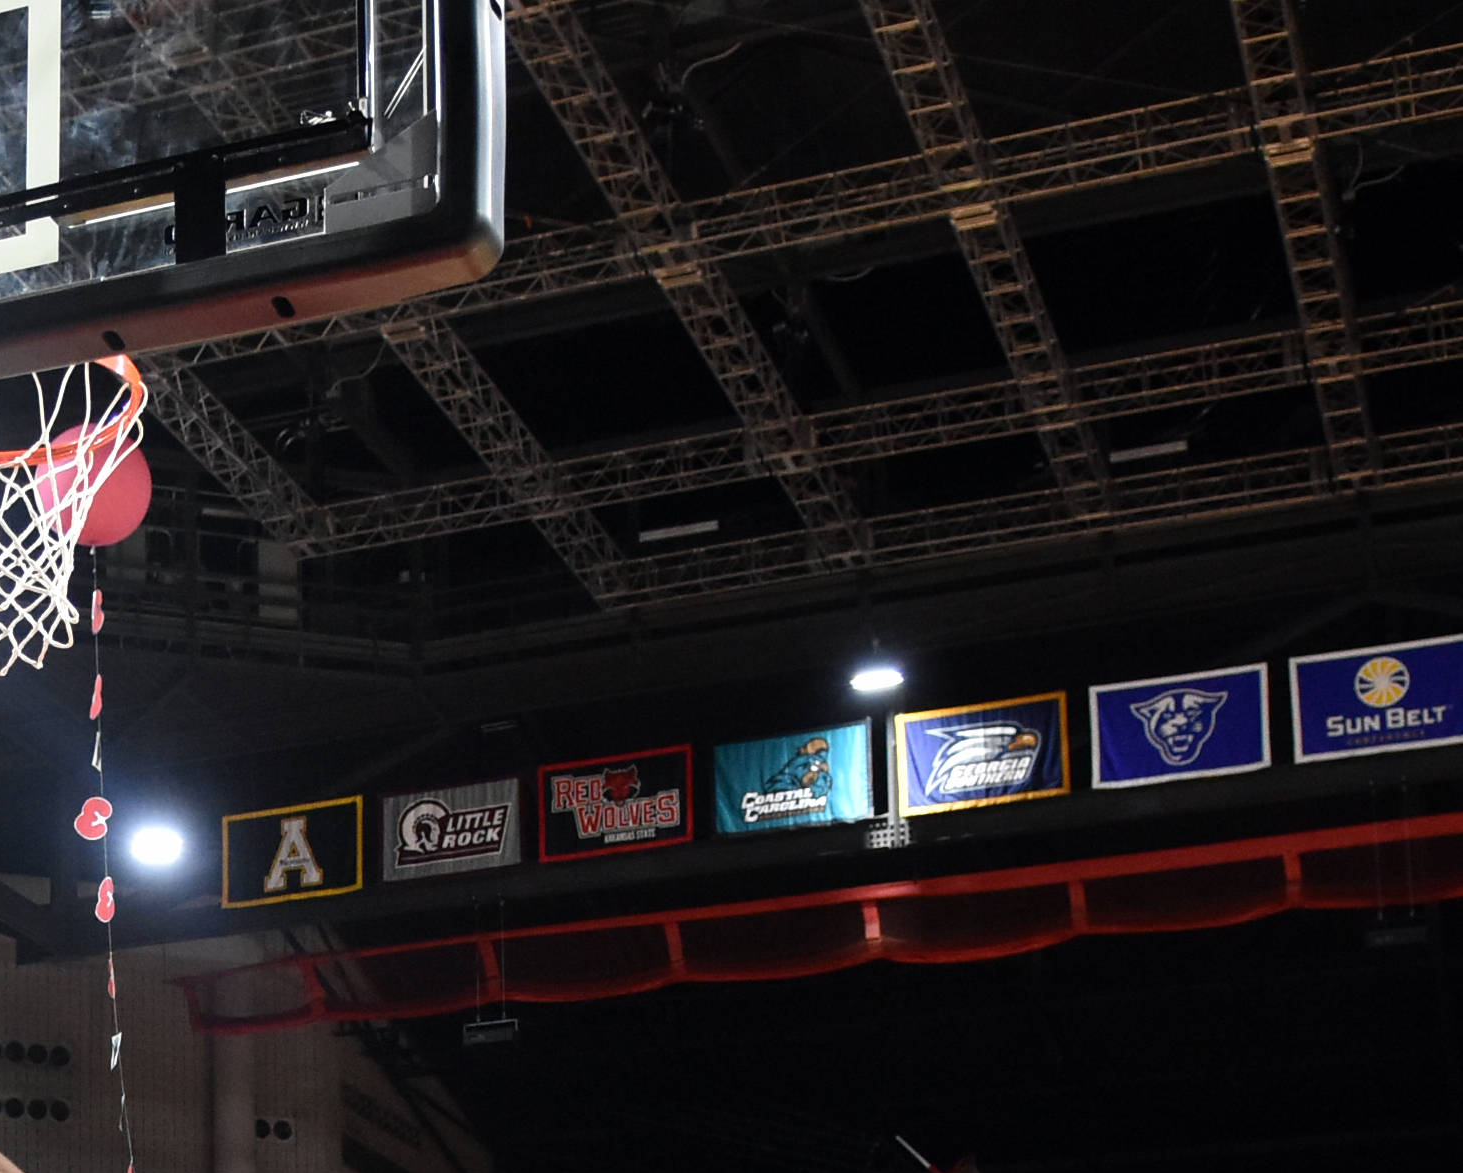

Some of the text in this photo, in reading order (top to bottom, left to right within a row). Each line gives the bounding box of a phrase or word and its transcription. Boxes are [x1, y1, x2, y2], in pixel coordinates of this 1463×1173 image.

[1326, 706, 1446, 737] SUN BELT
[553, 776, 603, 811] RED
[742, 788, 813, 810] COASTAL
[446, 809, 505, 833] LITTLE
[578, 792, 679, 836] WOLVES
[745, 796, 827, 823] CAROLINA
[442, 827, 501, 848] ROCK
[264, 816, 324, 892] A
